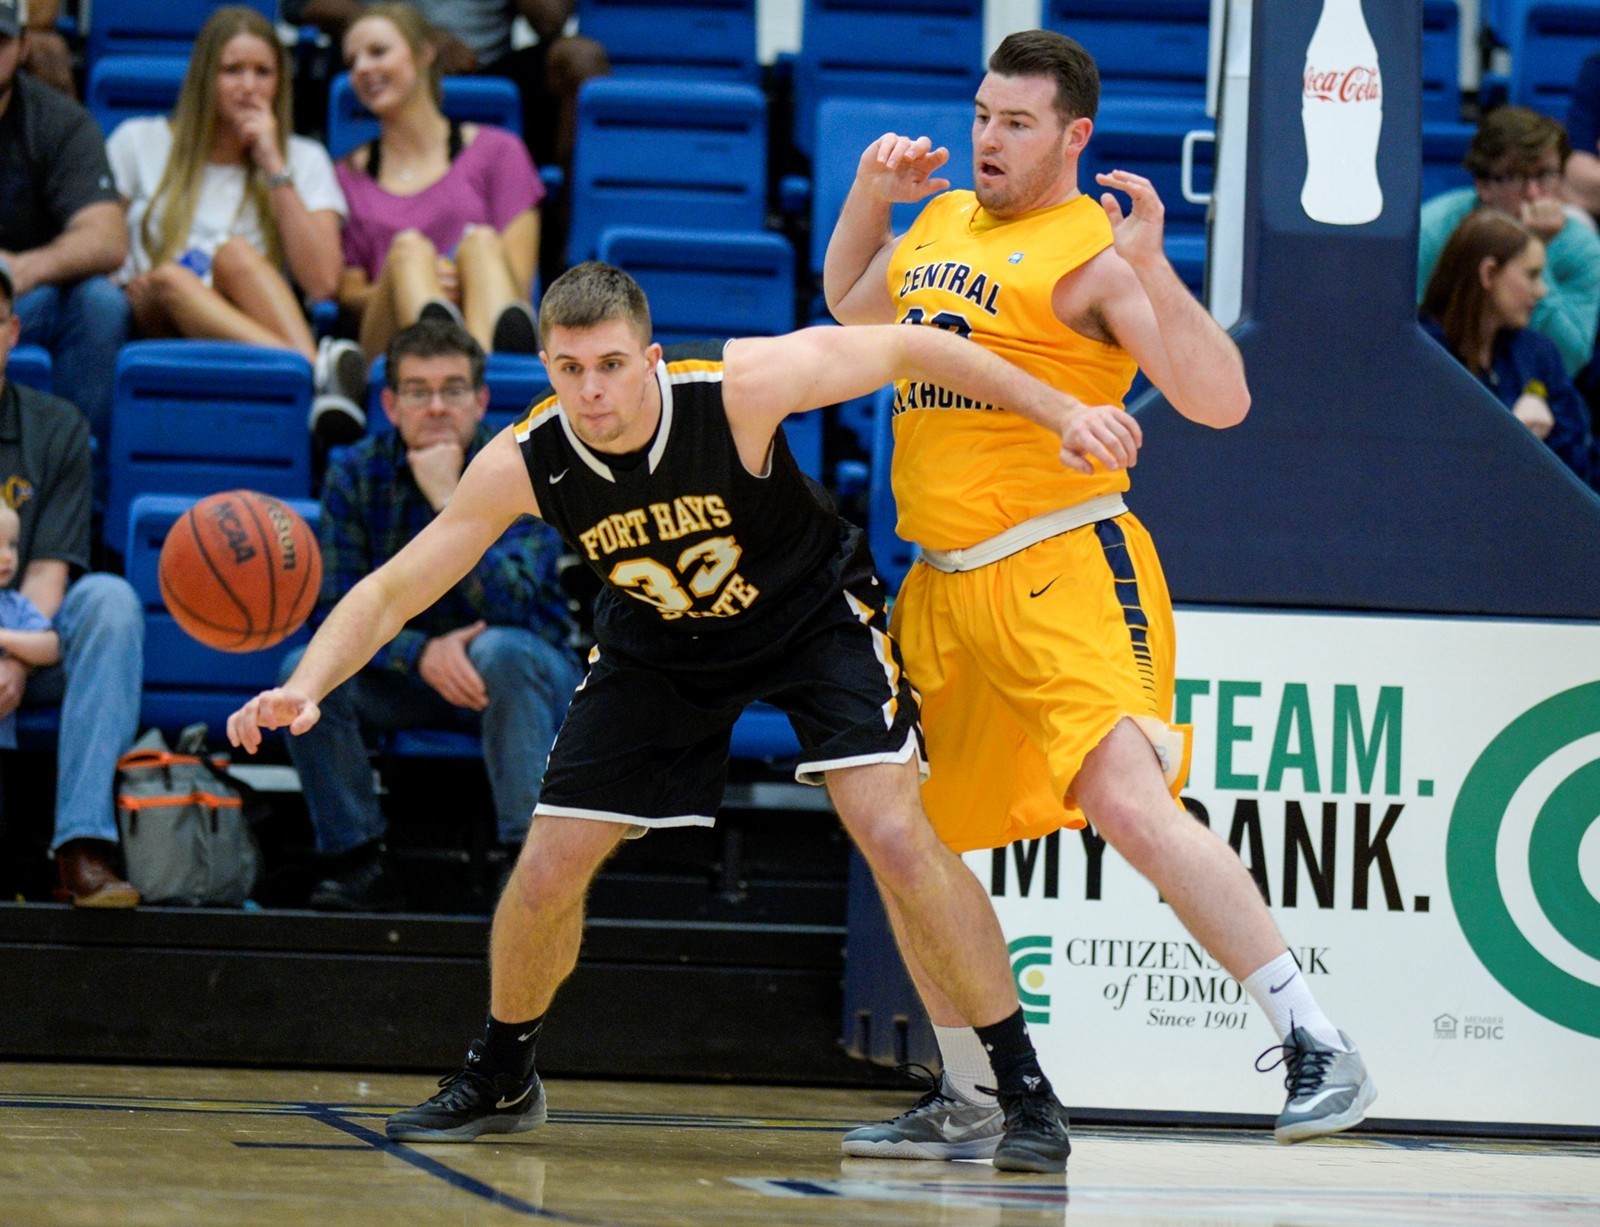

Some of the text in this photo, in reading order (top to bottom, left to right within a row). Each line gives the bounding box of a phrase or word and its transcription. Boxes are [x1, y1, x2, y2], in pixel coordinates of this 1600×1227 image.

[899, 261, 1002, 317] CENTRAL
[213, 502, 257, 565] NCAA
[578, 494, 733, 560] FORT HAYS
[1174, 678, 1435, 797] TEAM.
[990, 826, 1107, 901] MY
[1103, 974, 1251, 1011] of EDMO
[1147, 1008, 1249, 1030] Since 1901
[1463, 1025, 1504, 1040] FDIC
